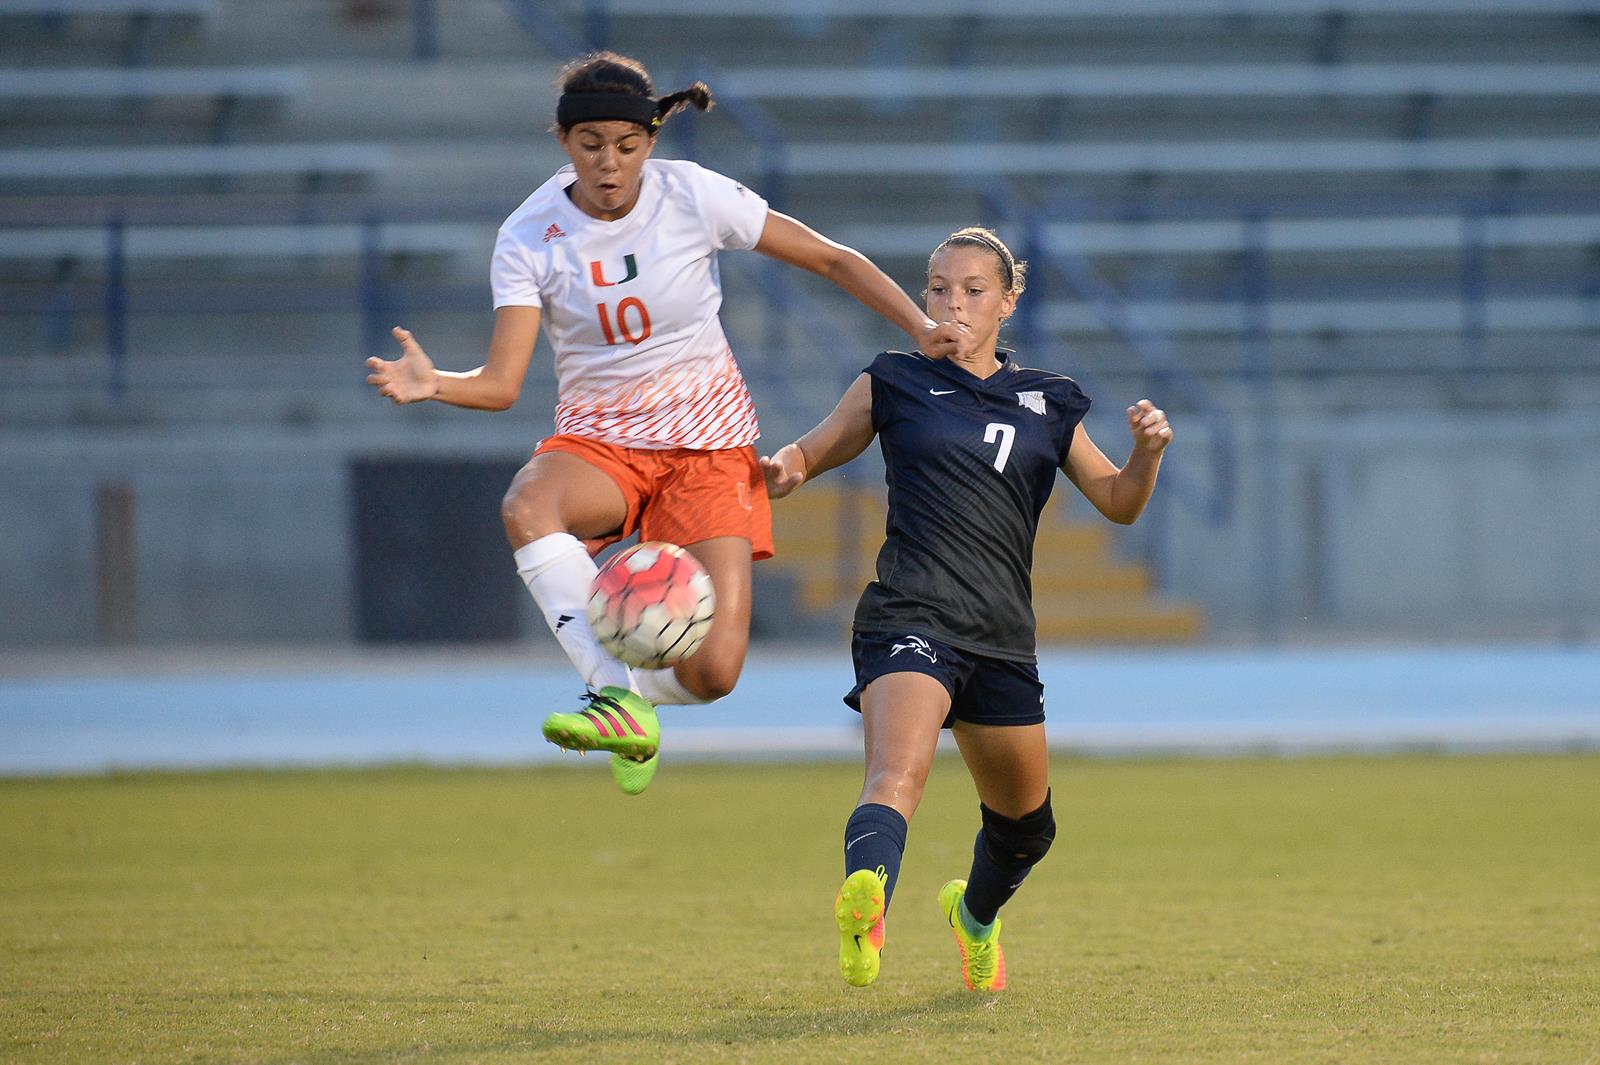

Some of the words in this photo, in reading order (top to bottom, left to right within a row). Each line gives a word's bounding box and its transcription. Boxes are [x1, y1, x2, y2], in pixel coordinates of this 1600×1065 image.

[590, 253, 638, 287] U
[596, 296, 653, 346] 10
[983, 422, 1016, 474] 7
